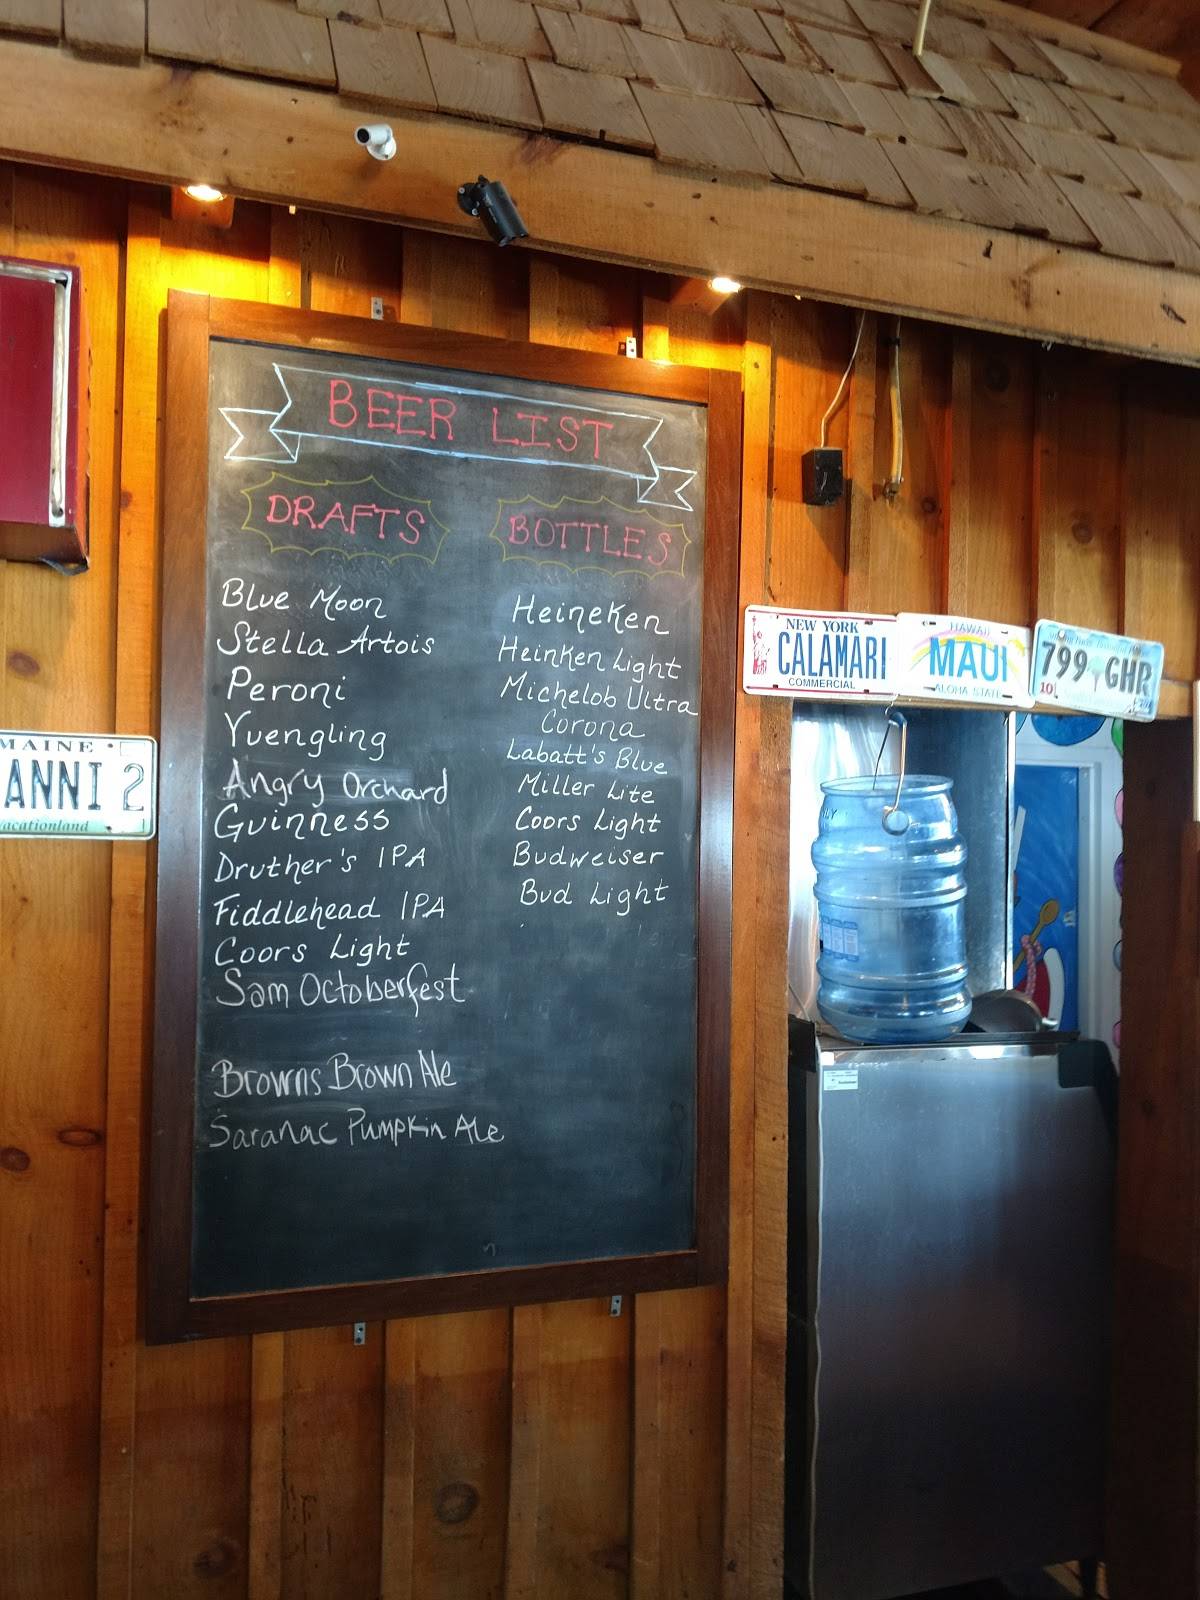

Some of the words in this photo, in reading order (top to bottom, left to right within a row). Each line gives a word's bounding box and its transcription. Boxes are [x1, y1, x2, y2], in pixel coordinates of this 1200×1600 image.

[328, 379, 457, 441] BEER
[491, 408, 615, 459] LIST
[266, 494, 426, 545] DRAFTS
[508, 515, 673, 565] BOTTLES
[222, 578, 290, 611] Blue
[310, 585, 387, 621] Moon
[512, 594, 670, 635] Heineken
[216, 621, 329, 655] Stella
[337, 625, 435, 654] Artois
[786, 618, 817, 631] NEW
[822, 620, 859, 634] YORK
[498, 635, 605, 672] Heinken
[613, 647, 682, 683] Light
[778, 631, 887, 680] CALAMARI
[929, 635, 1007, 683] MAUI
[1042, 640, 1088, 683] 799
[1105, 656, 1152, 697] GHR
[227, 666, 346, 709] Peroni
[500, 671, 617, 709] Michelob
[627, 685, 699, 716] Ultra
[788, 677, 856, 690] COMMERCIAL
[0, 738, 94, 753] MAINE
[224, 710, 387, 761] Yuengling
[541, 709, 645, 742] Corona
[506, 738, 606, 765] Labatt's
[615, 746, 668, 775] Blue
[123, 763, 145, 812] 2
[222, 758, 325, 808] Angry
[343, 767, 448, 804] Orchard
[517, 771, 595, 797] Miller
[607, 780, 655, 804] Lite
[0, 819, 89, 833] acationland
[214, 803, 390, 842] Guinness
[515, 806, 581, 832] Coors
[594, 808, 661, 840] Light
[214, 848, 357, 885] Druther's
[378, 844, 426, 869] IPA
[513, 840, 664, 868] Budweiser
[214, 893, 380, 930] Fiddlehead
[400, 891, 445, 921] IPA
[519, 878, 573, 905] Bud
[589, 879, 669, 916] Light
[214, 936, 307, 966] Coors
[330, 933, 410, 967] Light
[216, 967, 289, 1008] Sam
[299, 962, 466, 1018] Octoberfest
[211, 1059, 322, 1098] Browns
[326, 1052, 413, 1091] Brown
[417, 1049, 457, 1088] Ale
[347, 1107, 447, 1146] Pumpkin
[455, 1113, 505, 1145] Ale
